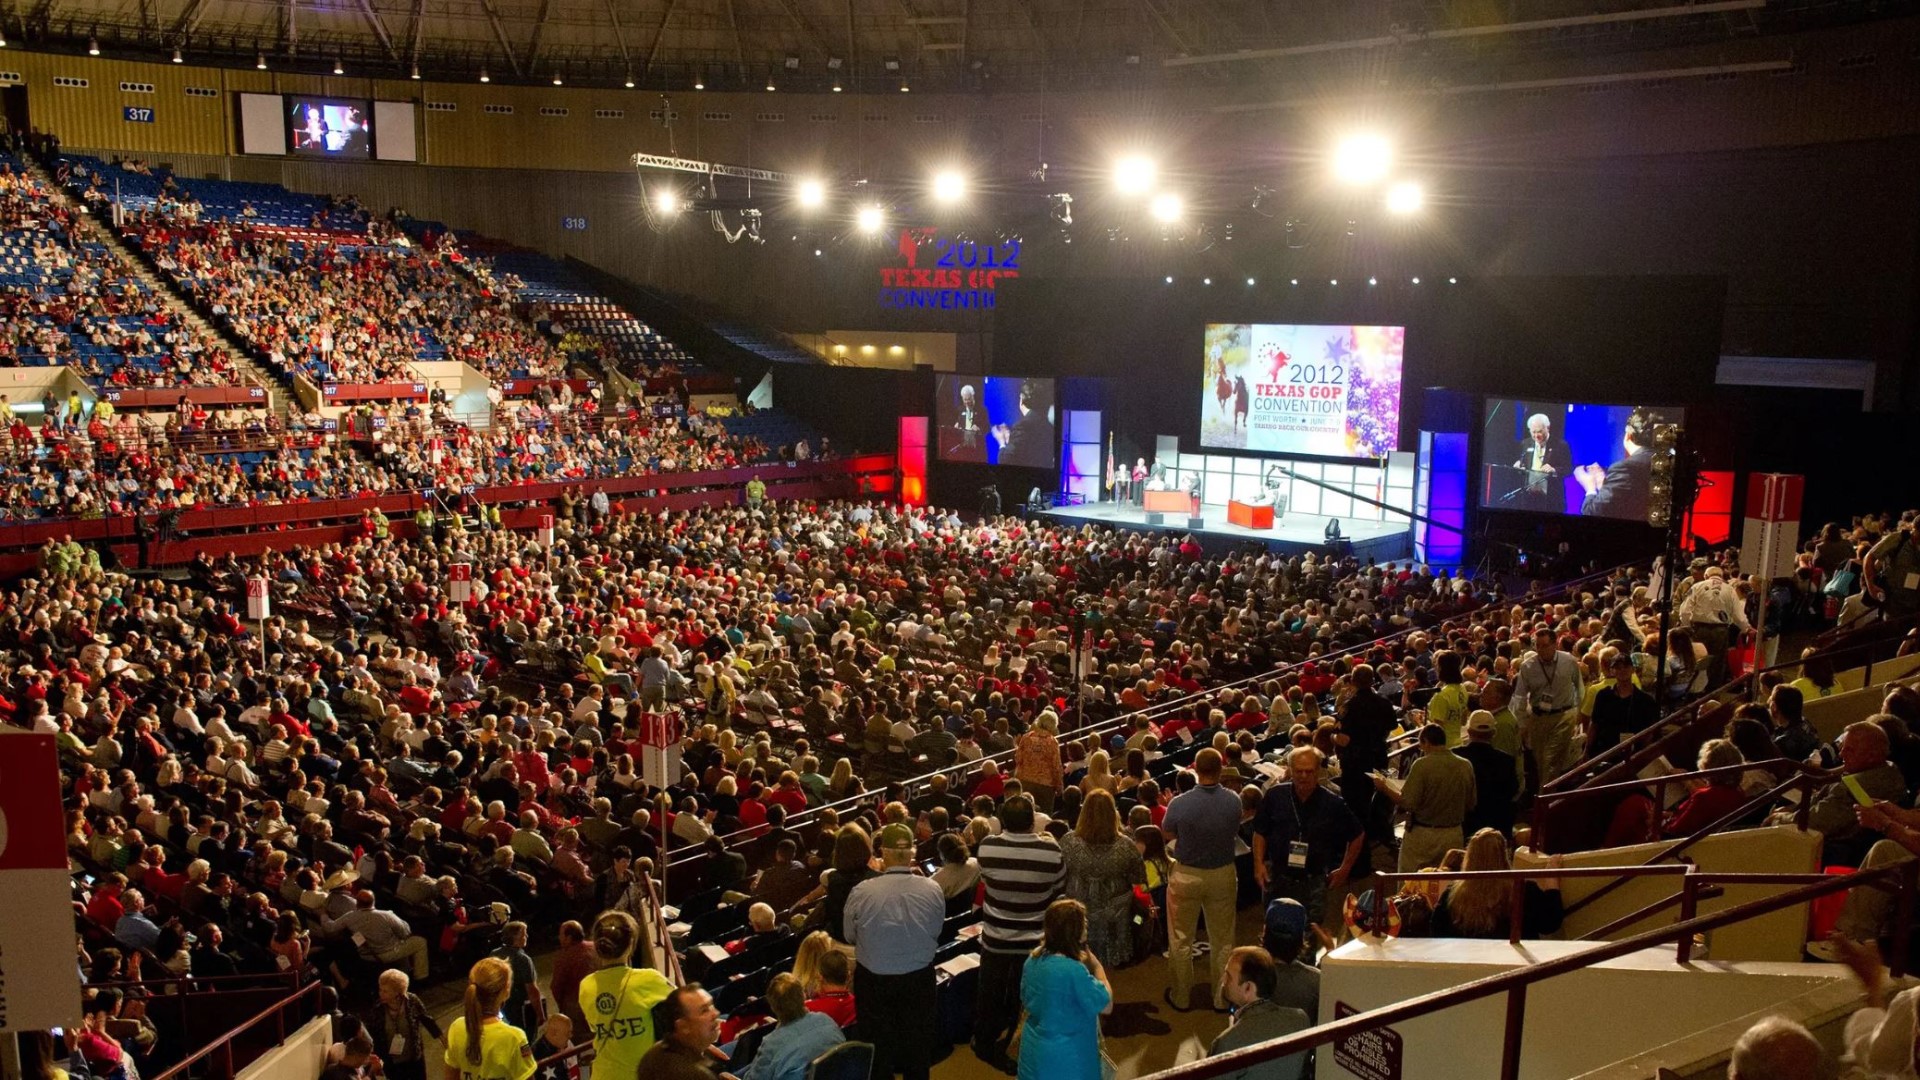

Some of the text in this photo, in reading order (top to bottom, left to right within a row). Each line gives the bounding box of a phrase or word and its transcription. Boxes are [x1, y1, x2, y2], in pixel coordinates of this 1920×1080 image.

[129, 108, 150, 121] 317
[566, 218, 585, 229] 318
[936, 238, 1021, 269] 2012
[880, 268, 962, 288] TEXAS
[1290, 364, 1343, 385] 2012
[324, 387, 337, 395] 317
[1256, 384, 1342, 399] TEXAS GOP
[1254, 397, 1342, 413] CONVENTION
[324, 421, 336, 429] 211
[457, 566, 463, 580] 5
[250, 580, 261, 597] 26
[1344, 1042, 1391, 1076] PROHIBITED
[1348, 1037, 1359, 1049] OR
[1361, 1045, 1388, 1066] AISLES
